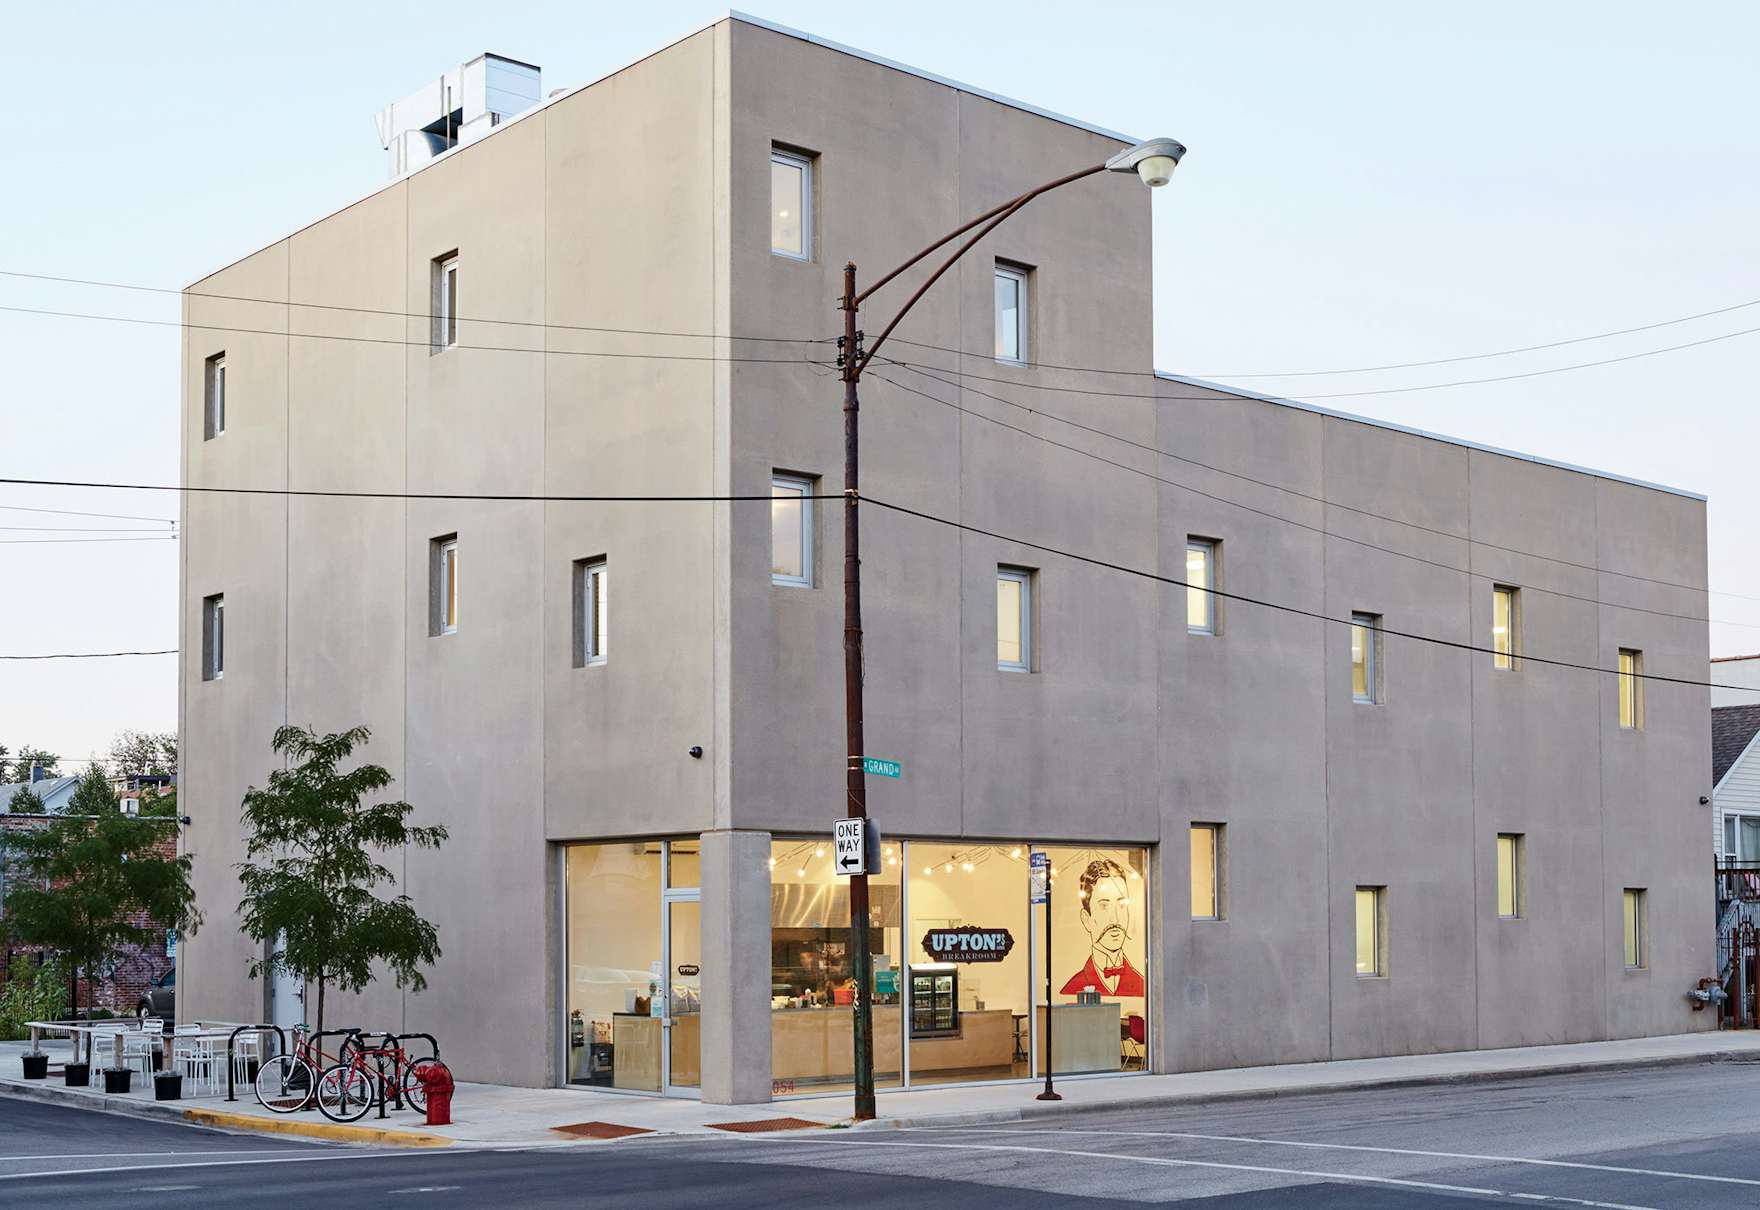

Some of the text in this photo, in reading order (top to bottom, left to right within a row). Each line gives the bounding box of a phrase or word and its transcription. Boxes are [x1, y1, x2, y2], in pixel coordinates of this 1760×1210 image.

[868, 760, 894, 776] GRAND
[838, 824, 859, 837] ONE
[838, 839, 860, 853] WAY
[932, 933, 1005, 951] UPTON'S
[942, 952, 997, 960] BREAKROOM
[771, 1080, 794, 1094] 054
